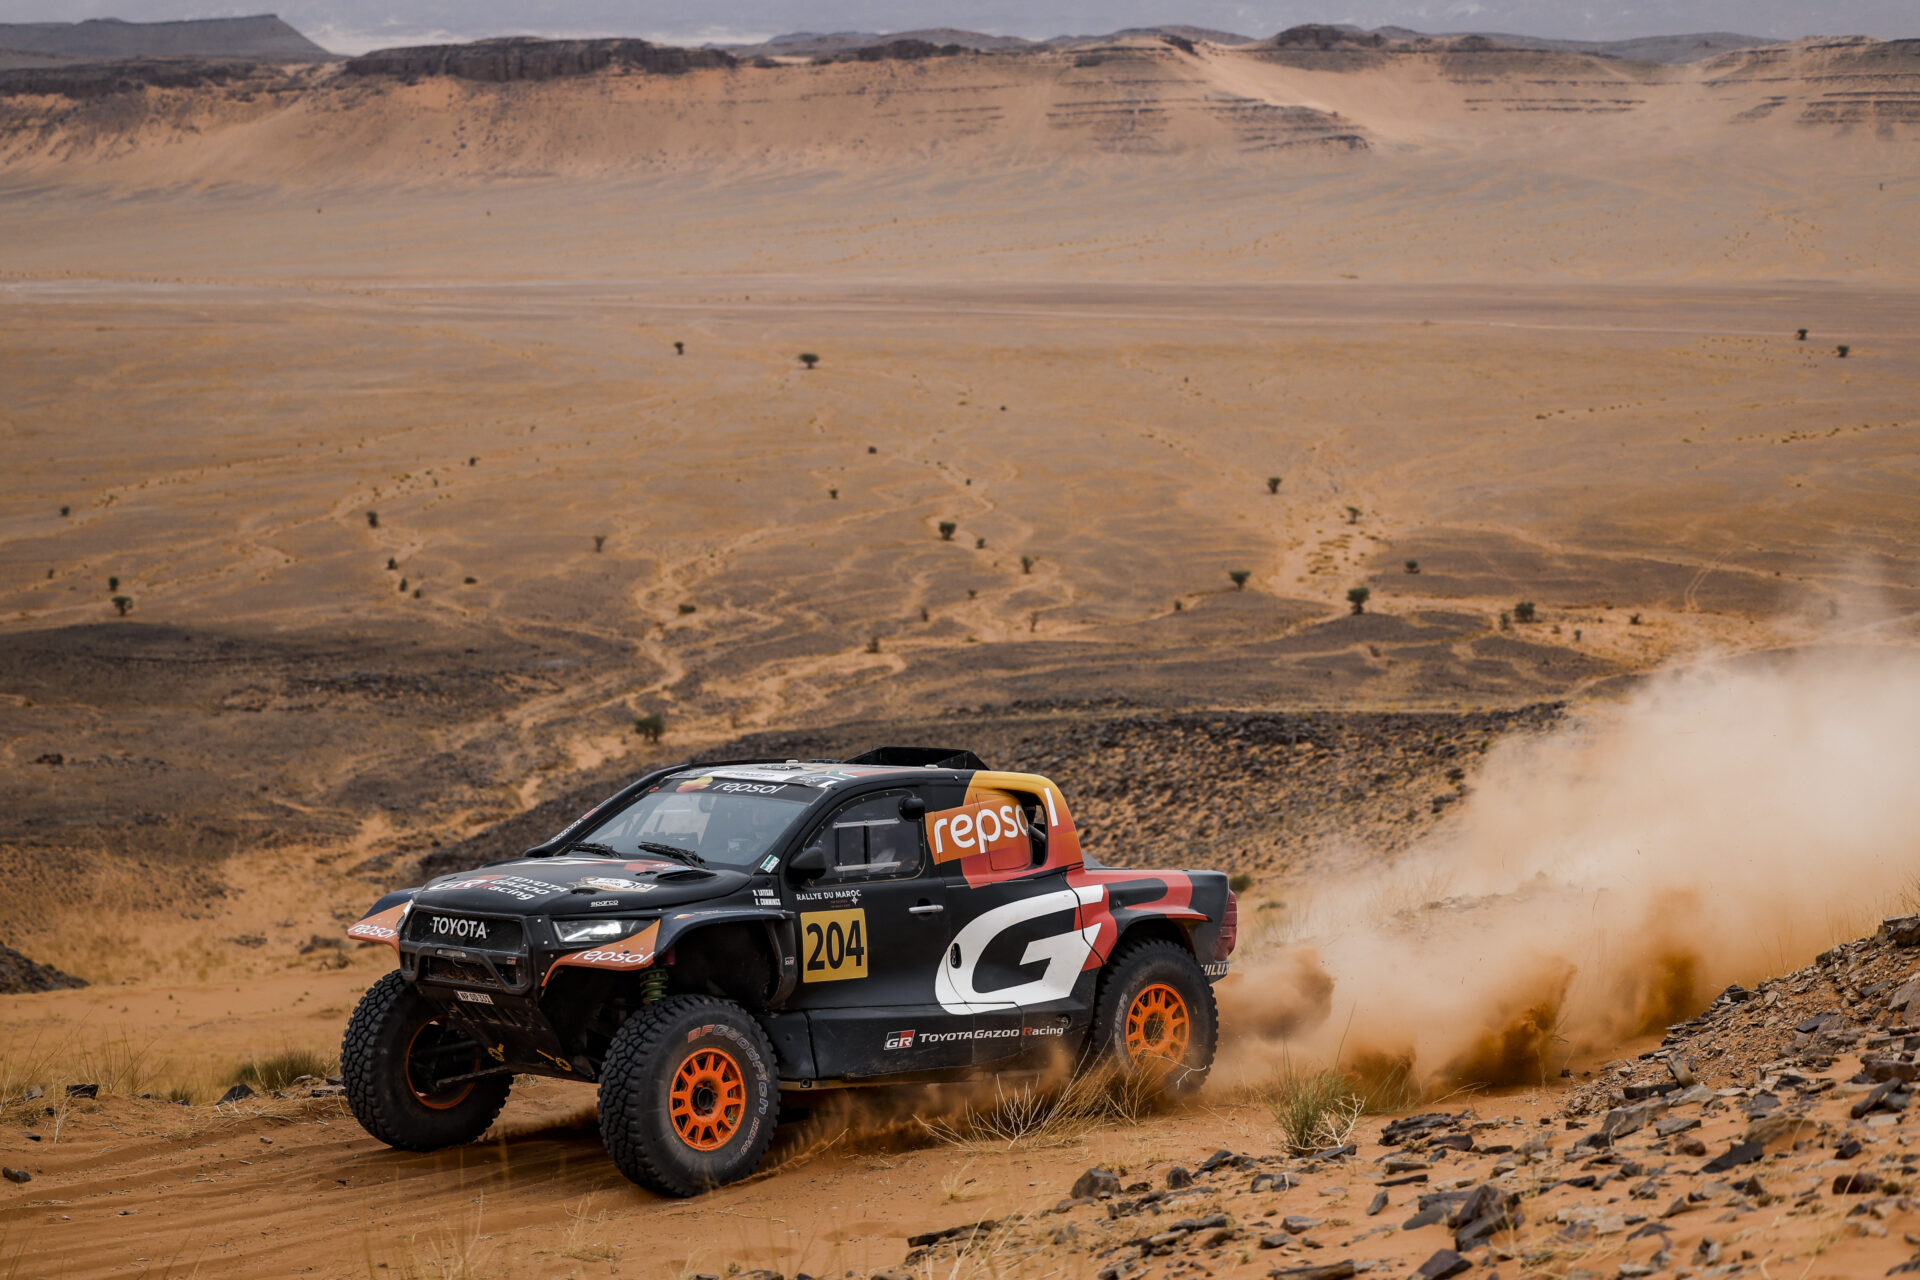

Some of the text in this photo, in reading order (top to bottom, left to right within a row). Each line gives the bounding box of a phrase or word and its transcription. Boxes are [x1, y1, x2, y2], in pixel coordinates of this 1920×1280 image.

[713, 782, 788, 794] repsol
[934, 787, 1059, 854] repsol
[477, 883, 535, 901] Racing
[490, 879, 551, 895] GAZOO
[506, 876, 569, 893] TOYOTA
[796, 889, 862, 901] RALLYE DU MAROC
[590, 900, 619, 908] sparco
[350, 924, 398, 938] repsol
[432, 916, 487, 939] TOYOTA
[806, 920, 864, 971] 204
[572, 950, 655, 964] repsol
[885, 1026, 1064, 1048] GR TOYOTA GAZOO Racing
